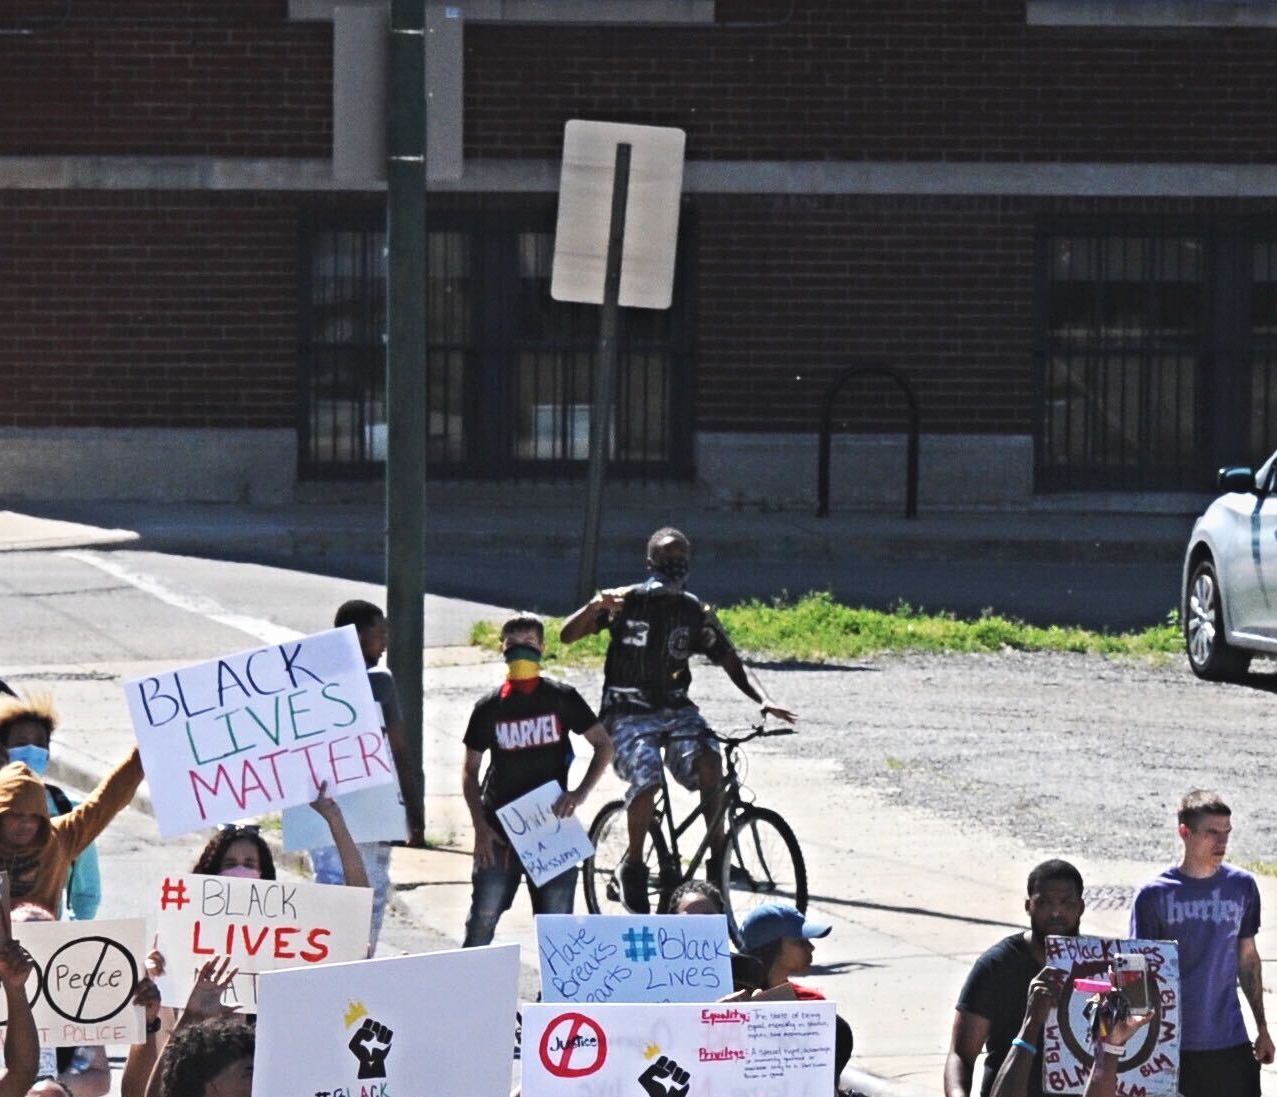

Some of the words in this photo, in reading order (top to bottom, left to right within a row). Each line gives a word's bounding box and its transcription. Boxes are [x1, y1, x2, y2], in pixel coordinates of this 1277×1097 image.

[138, 643, 326, 728] BLACK
[184, 682, 358, 766] LIVES
[495, 714, 561, 750] MARVEL
[188, 730, 393, 820] MATTER
[201, 878, 299, 920] BLACK
[1165, 888, 1246, 939] hurley
[192, 920, 333, 964] LIVES
[539, 928, 596, 977] Hate
[55, 963, 124, 994] Peace
[551, 942, 619, 999] Breaks
[580, 965, 634, 1003] earts
[646, 965, 721, 991] Lives
[62, 1024, 129, 1043] POLICE
[1160, 989, 1178, 1044] BLM
[549, 1034, 598, 1053] Justice
[1045, 1025, 1061, 1064] BLM
[1140, 1052, 1175, 1078] BLM
